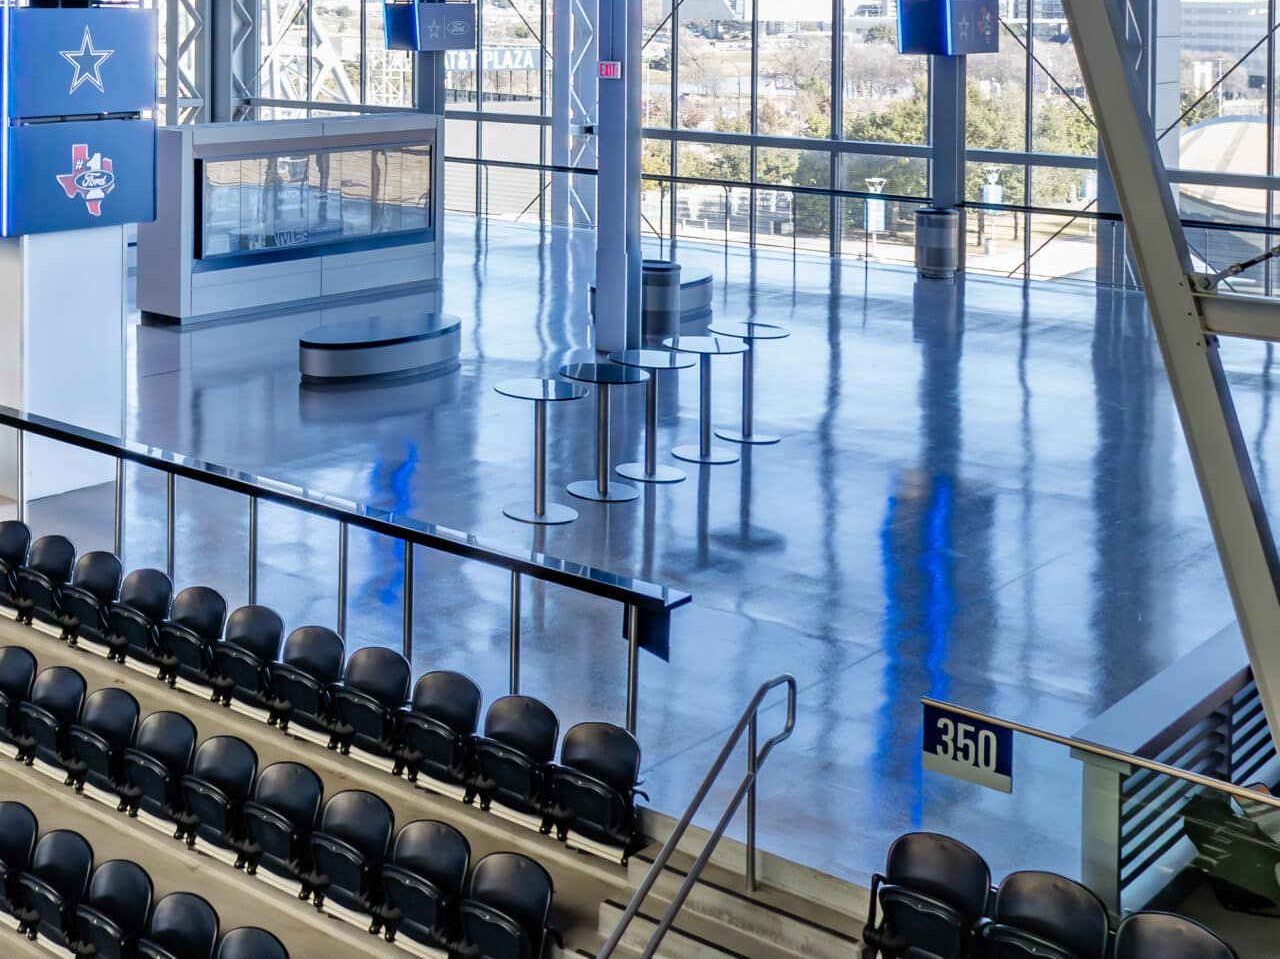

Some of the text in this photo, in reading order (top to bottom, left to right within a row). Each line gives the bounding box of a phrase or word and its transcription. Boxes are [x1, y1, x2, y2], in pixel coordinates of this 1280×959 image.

[481, 48, 535, 70] PLAZA
[81, 173, 107, 187] Ford
[936, 717, 997, 772] 350
